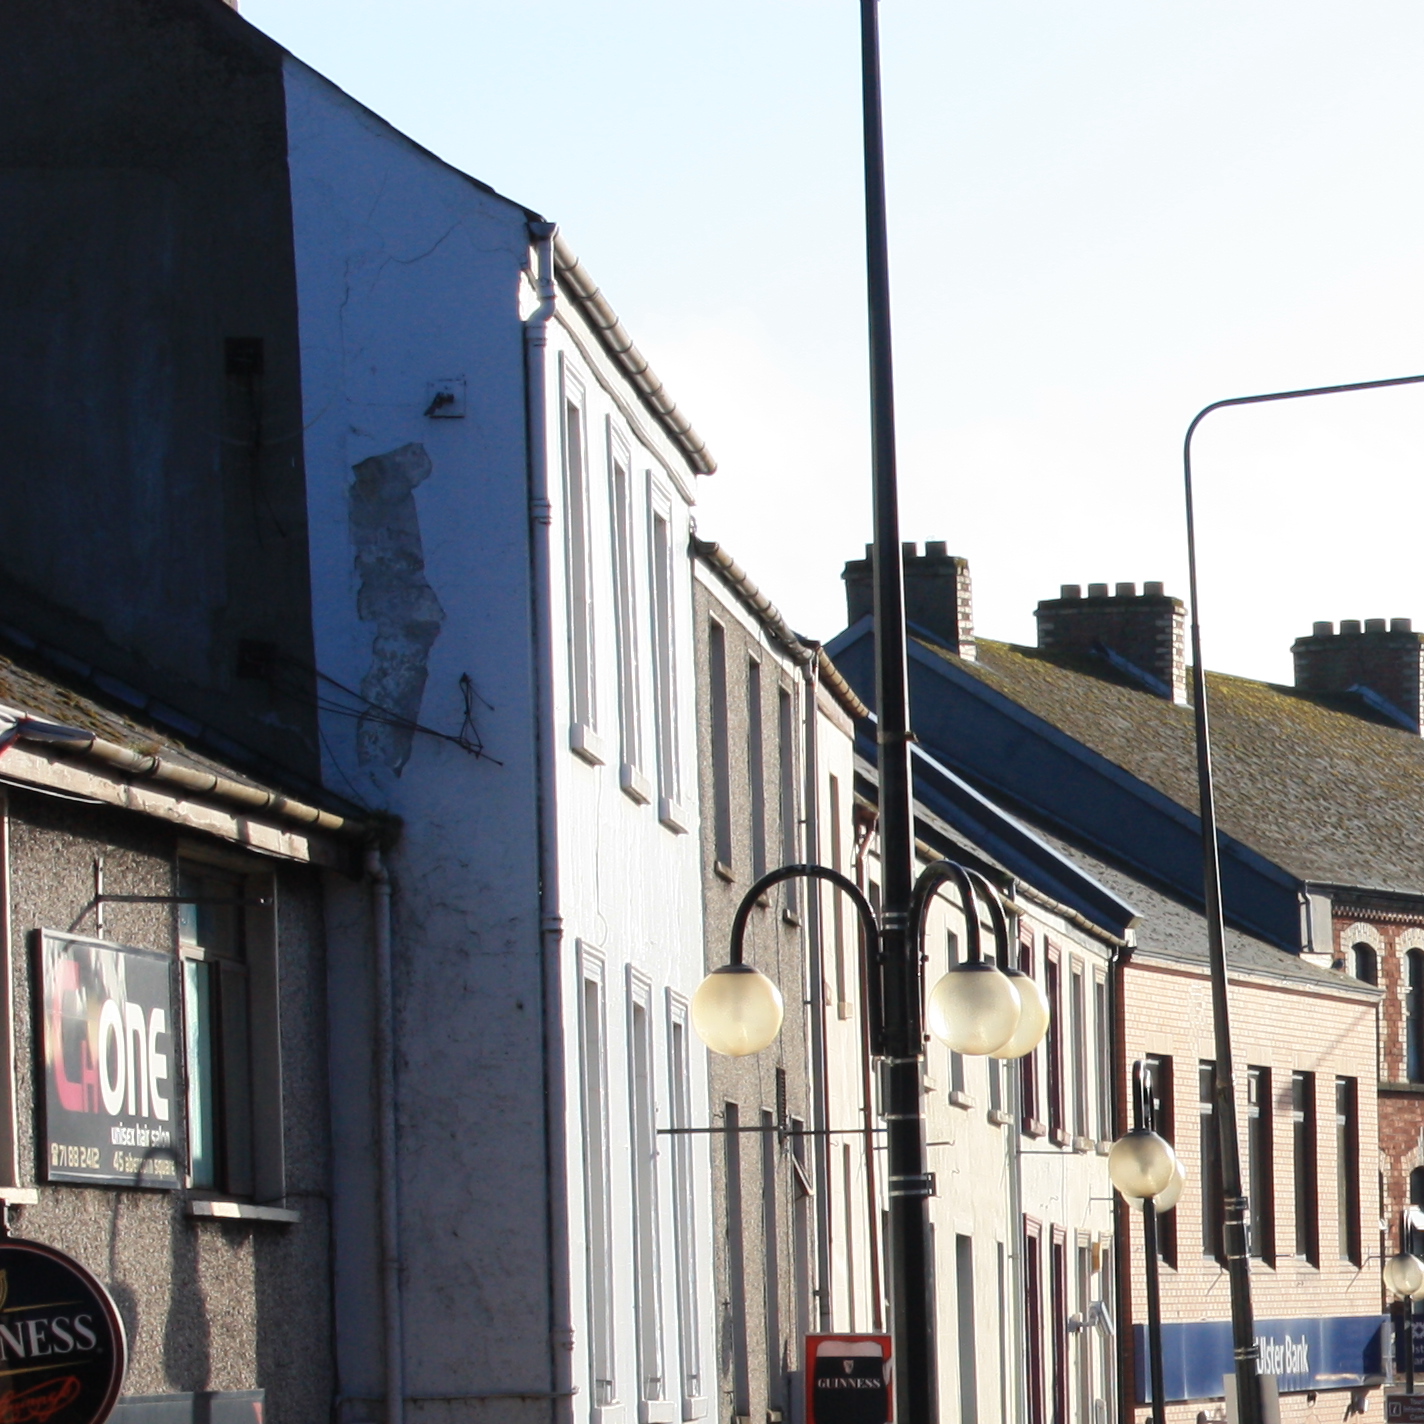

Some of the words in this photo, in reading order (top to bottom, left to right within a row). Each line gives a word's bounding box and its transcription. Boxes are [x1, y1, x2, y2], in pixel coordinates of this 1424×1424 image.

[111, 1121, 136, 1146] unisex
[136, 1123, 150, 1147] hair
[150, 1124, 171, 1149] salon
[113, 1151, 124, 1172] 45
[1254, 1335, 1284, 1375] Ulster
[1285, 1334, 1310, 1374] Bank
[817, 1377, 881, 1389] GUINNESS
